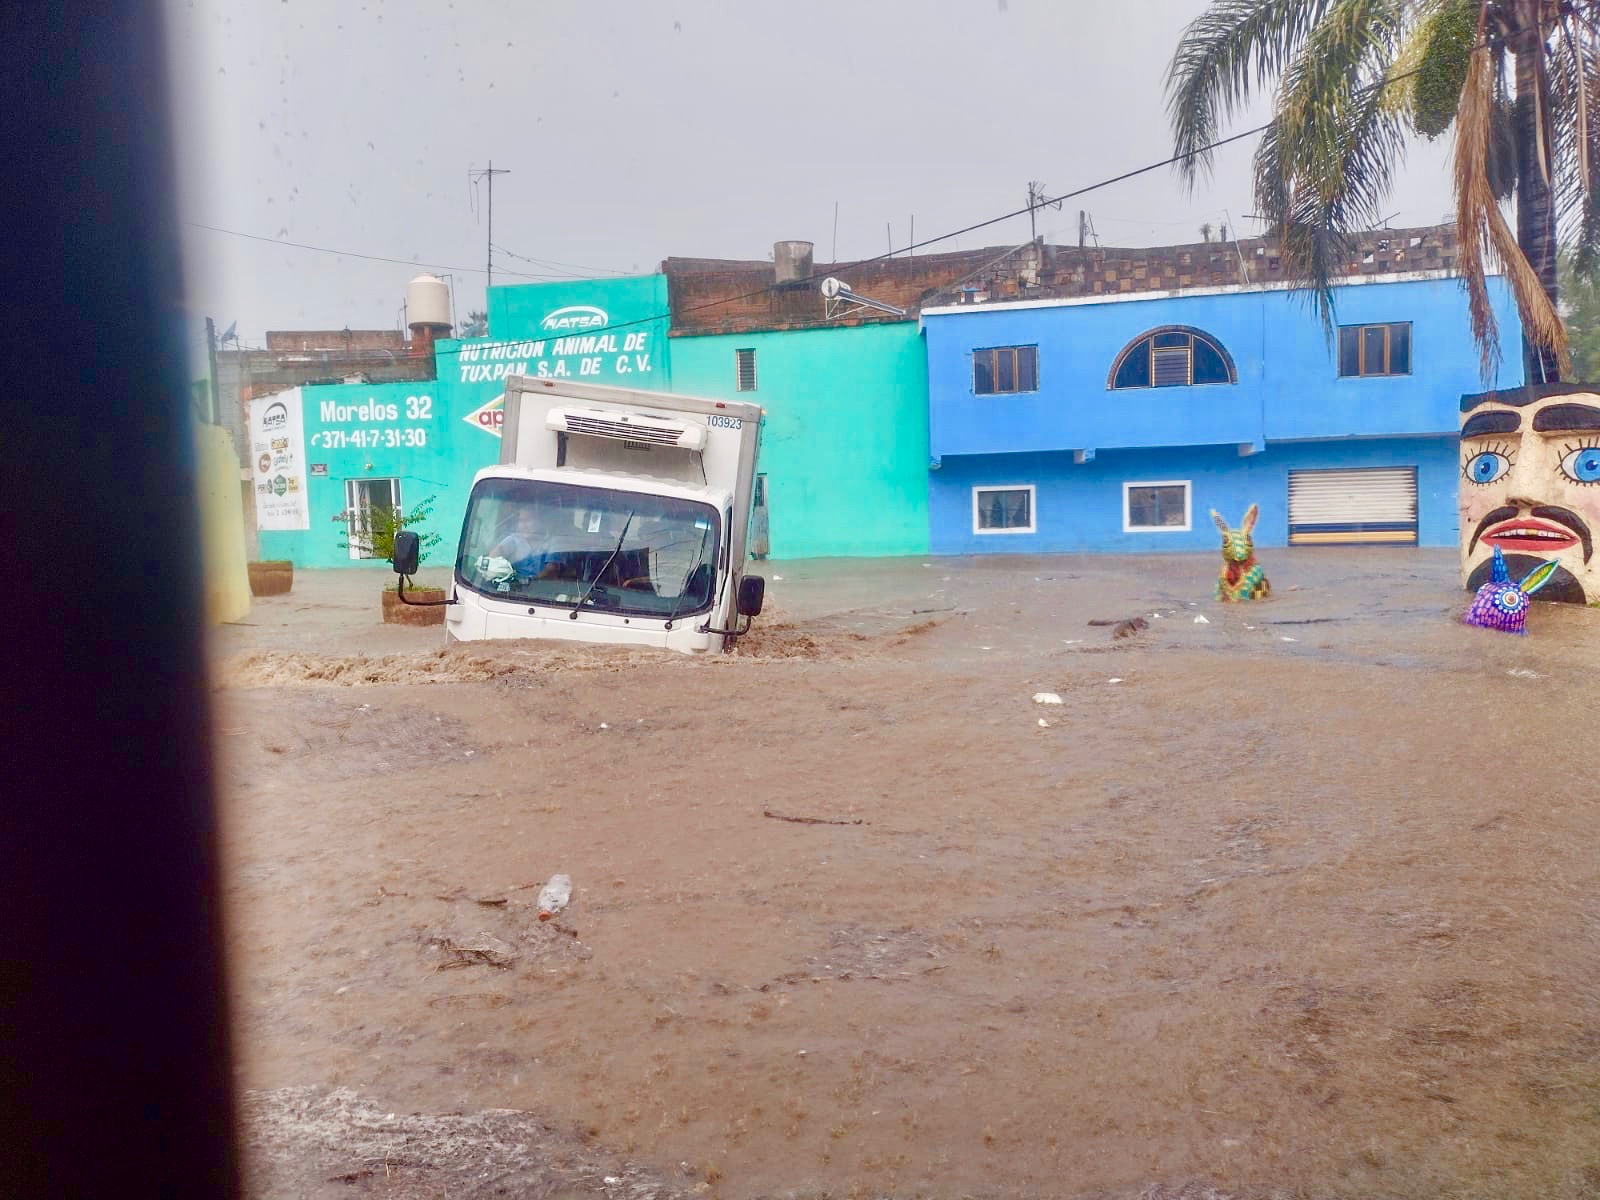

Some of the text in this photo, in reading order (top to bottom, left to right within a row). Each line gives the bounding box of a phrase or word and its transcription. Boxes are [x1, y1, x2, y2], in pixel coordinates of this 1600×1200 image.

[543, 315, 602, 330] NATSA
[459, 332, 647, 361] NUTRICION ANIMAL DE
[460, 361, 528, 383] TUXPAN
[580, 356, 603, 375] DE
[320, 396, 432, 422] Morelos 32
[706, 415, 742, 430] 103923
